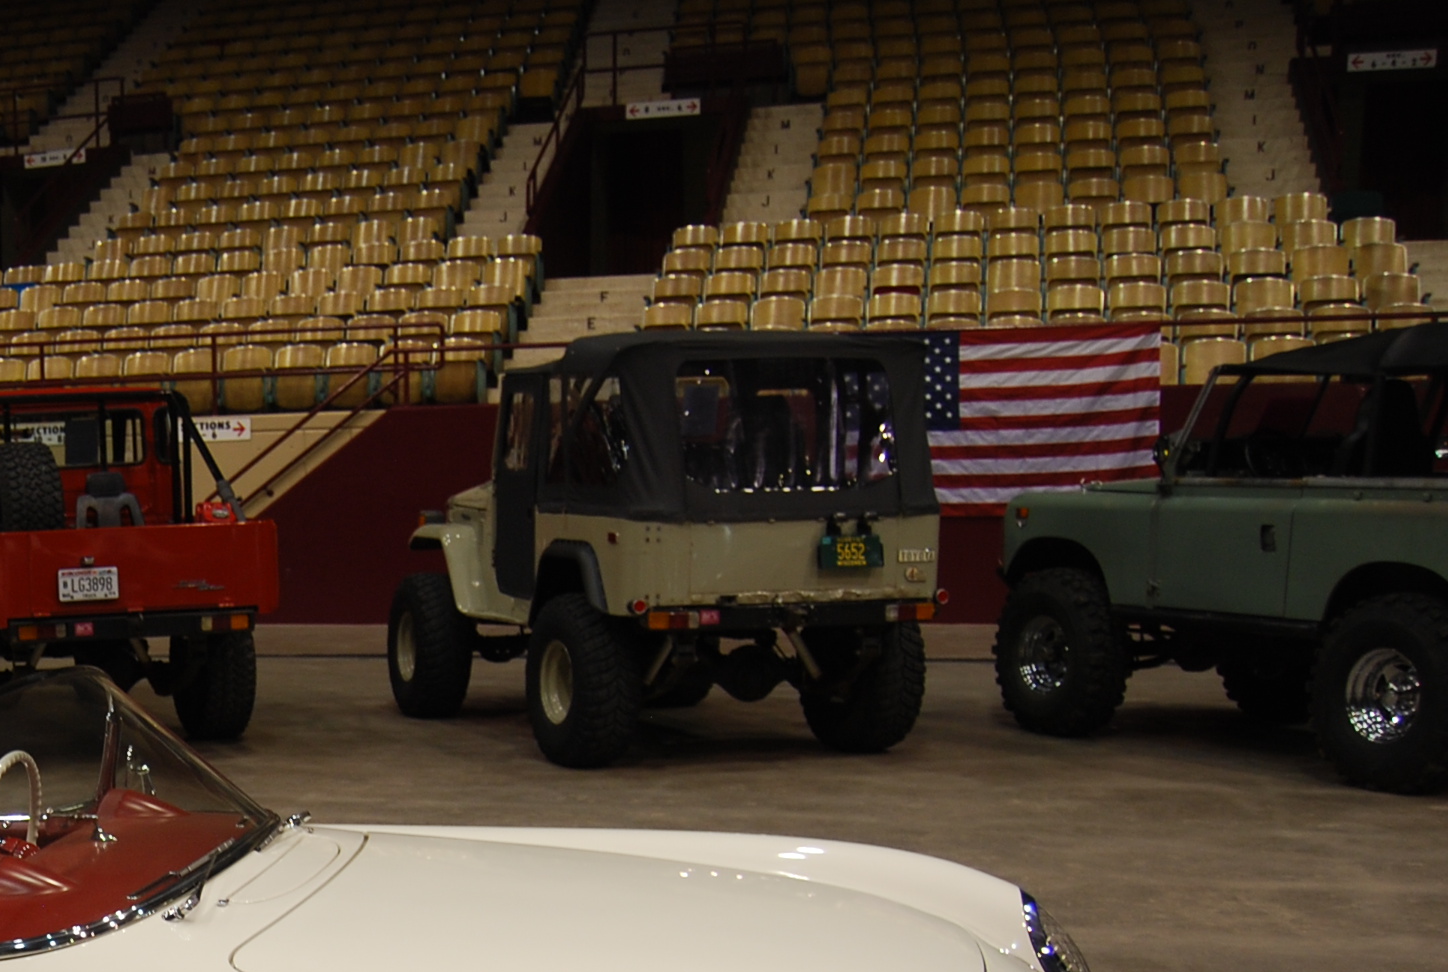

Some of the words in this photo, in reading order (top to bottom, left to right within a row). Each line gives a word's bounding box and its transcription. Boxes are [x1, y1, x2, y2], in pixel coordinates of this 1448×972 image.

[600, 291, 609, 303] F
[587, 317, 596, 330] E
[836, 542, 866, 560] 5652
[71, 576, 113, 593] LG3898
